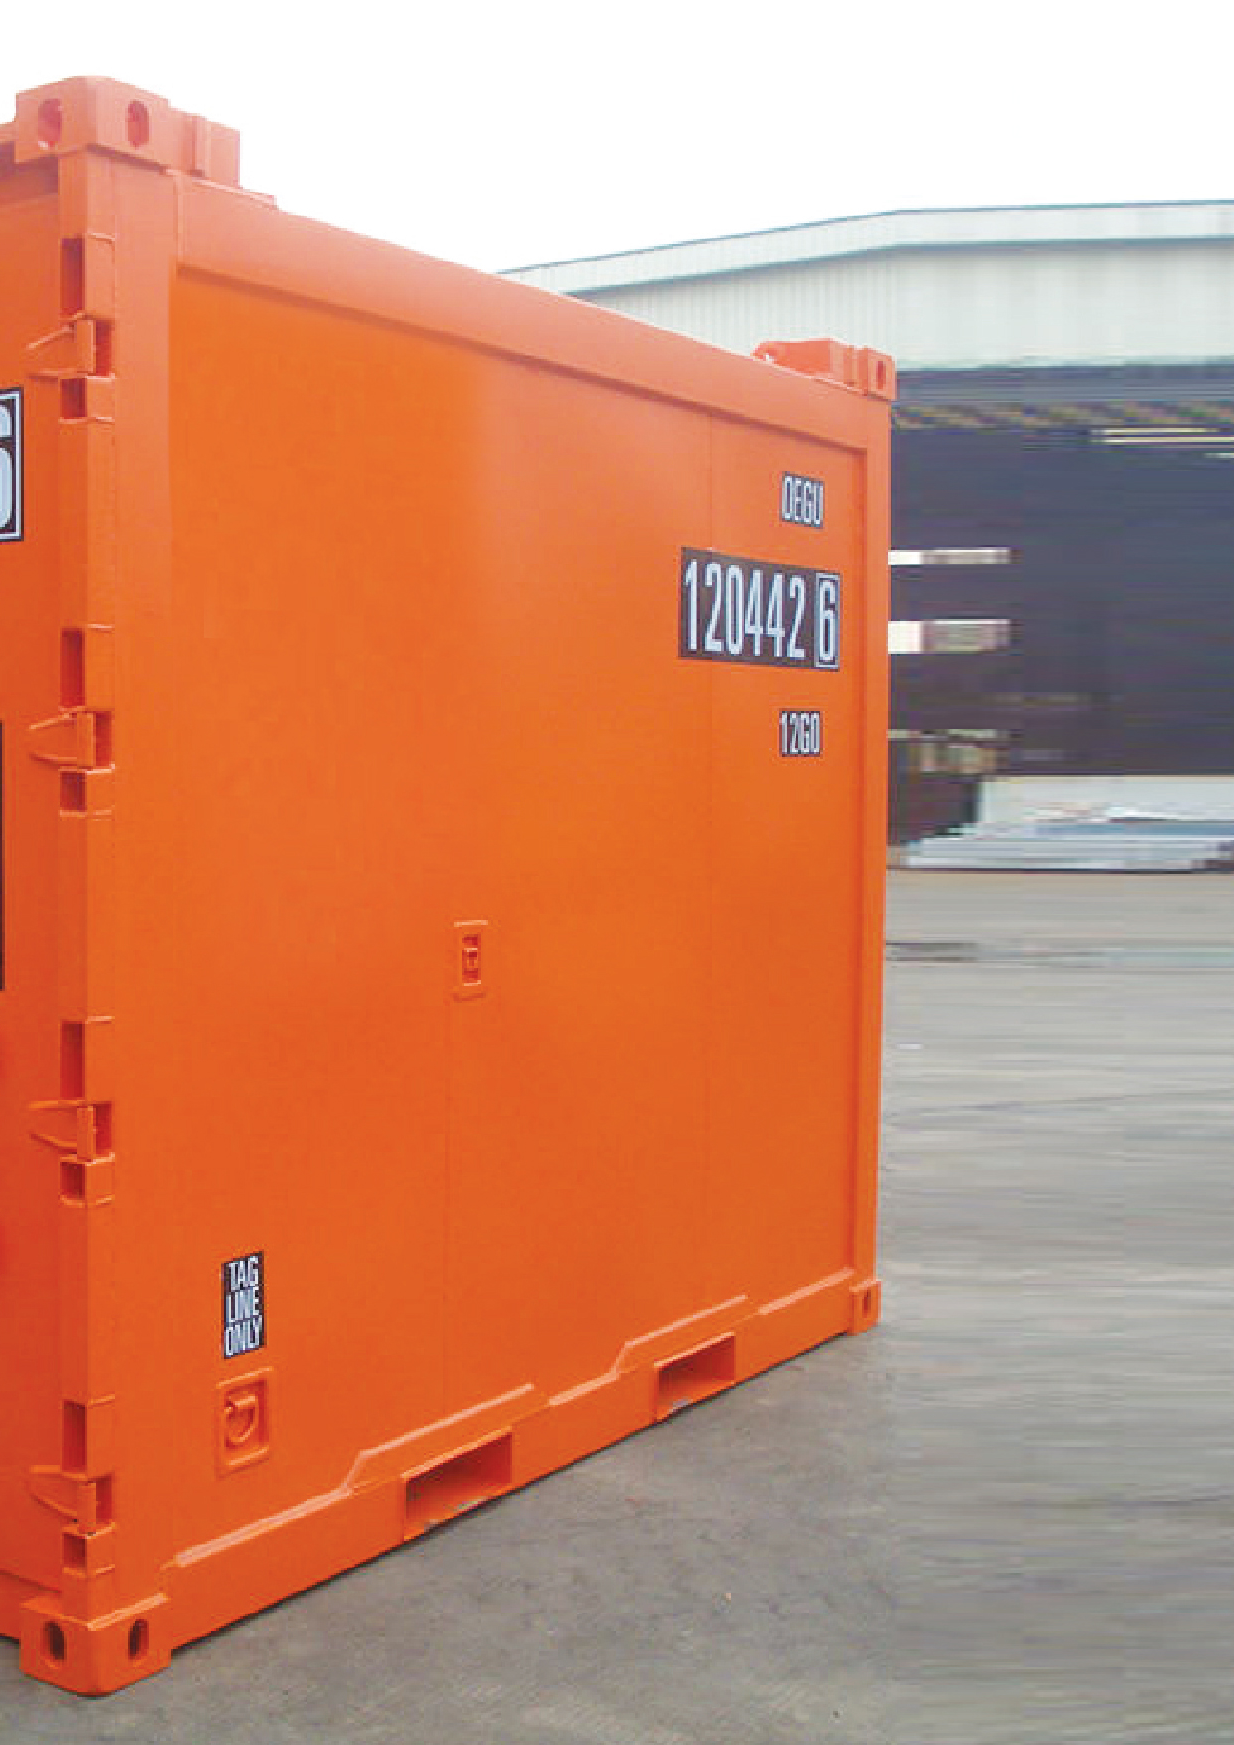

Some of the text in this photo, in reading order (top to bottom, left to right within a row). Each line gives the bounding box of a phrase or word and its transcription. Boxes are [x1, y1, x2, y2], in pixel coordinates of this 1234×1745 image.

[230, 1256, 259, 1291] TAG
[226, 1286, 259, 1323] LINE
[225, 1315, 263, 1356] ONLY
